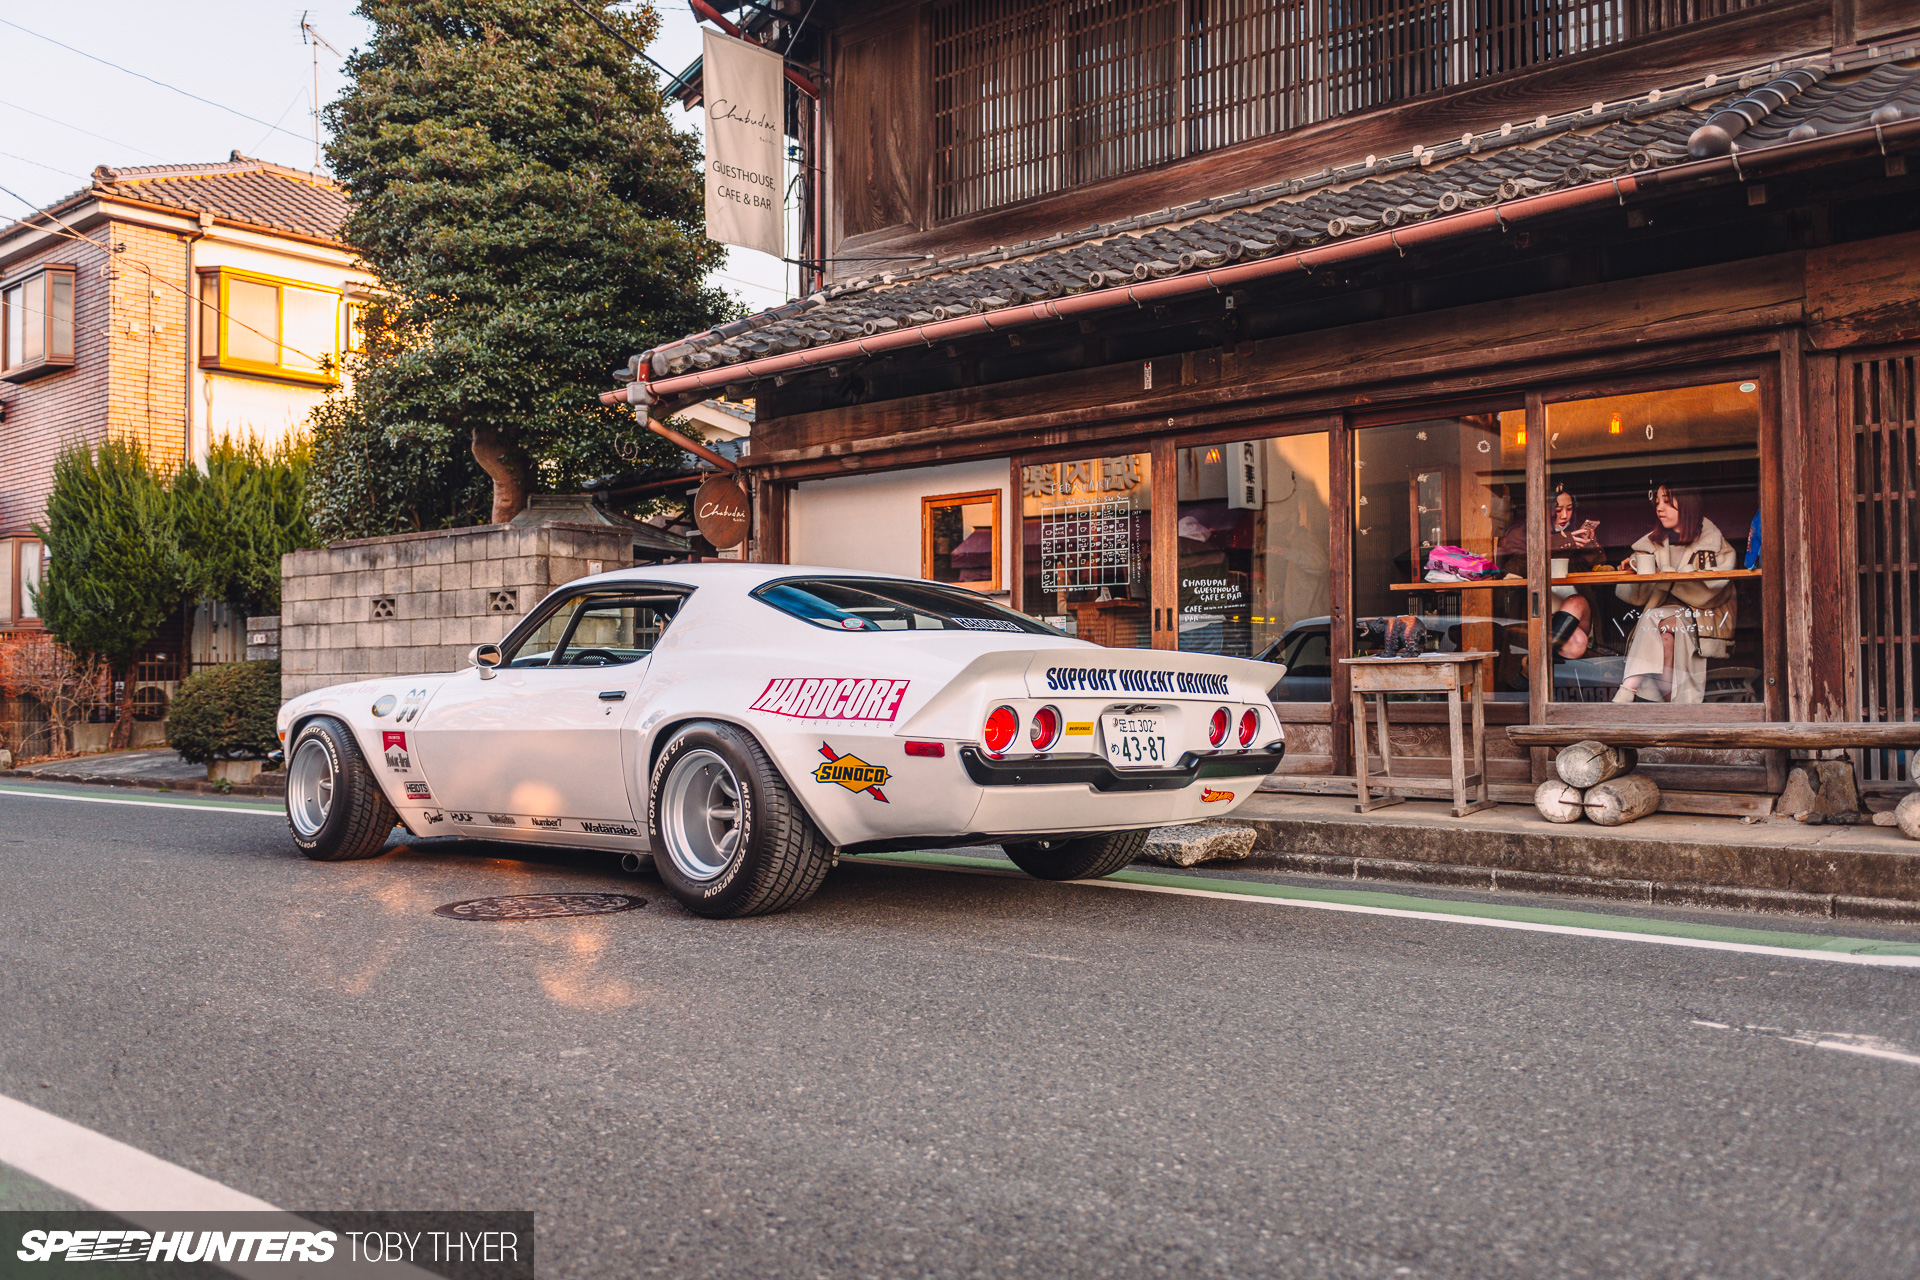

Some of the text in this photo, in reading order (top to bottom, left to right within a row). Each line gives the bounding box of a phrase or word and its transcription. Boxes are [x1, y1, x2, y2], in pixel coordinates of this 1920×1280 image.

[709, 98, 776, 131] Chabudai
[712, 160, 776, 191] GUESTHOUSE,
[717, 185, 772, 211] CAFE & BAR
[1050, 477, 1112, 496] FEBRUARY
[700, 502, 746, 519] Chabudai
[1193, 584, 1240, 595] GUESTHOUSE
[1200, 593, 1220, 602] CAFE
[1226, 591, 1242, 601] BAR
[1184, 604, 1203, 613] CAFE
[1046, 667, 1230, 696] SUPPORT VIOLENT DRIVING
[749, 678, 911, 721] HARDCORE
[1138, 719, 1154, 733] 302
[1122, 736, 1165, 762] 43-87
[819, 765, 885, 783] SUNOCO
[406, 783, 428, 793] HEIDTS
[649, 736, 686, 836] SPORTSMAN S/T
[581, 821, 638, 836] Watanabe
[704, 781, 752, 899] MICKEY THOMPSON
